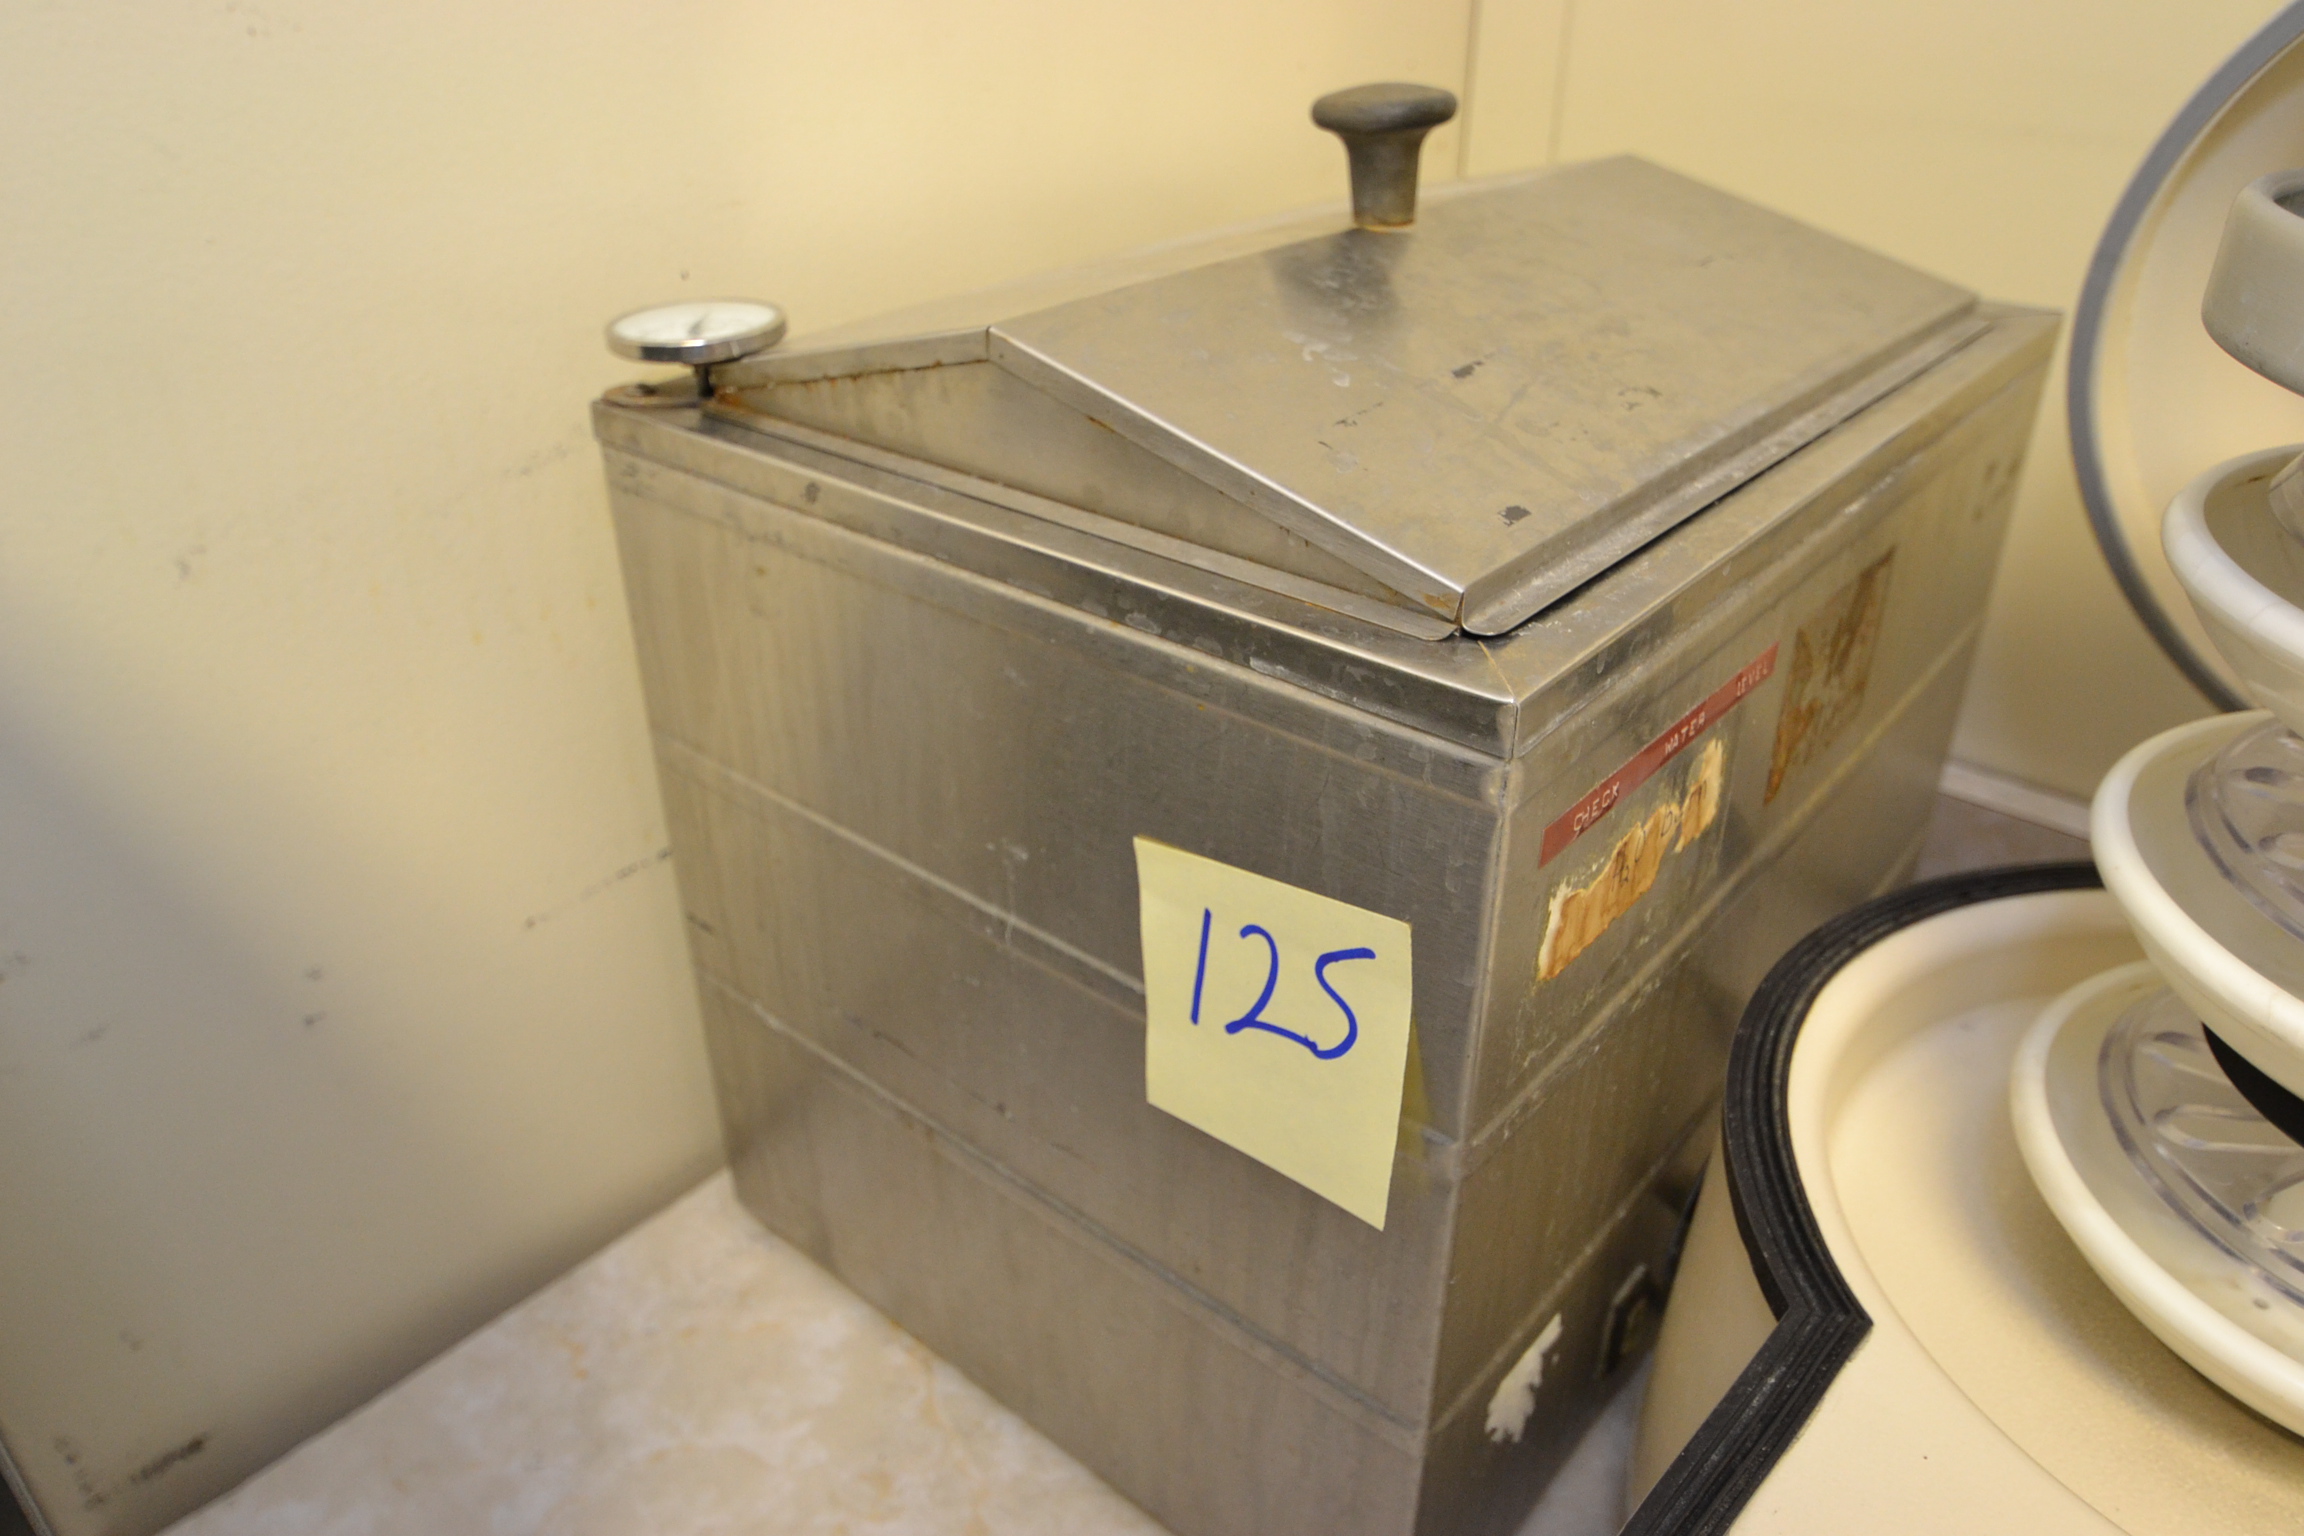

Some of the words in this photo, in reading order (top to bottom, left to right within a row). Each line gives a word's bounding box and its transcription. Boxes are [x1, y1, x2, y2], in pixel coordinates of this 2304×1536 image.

[1573, 780, 1620, 832] CHECK
[1664, 710, 1706, 754] WATER
[1736, 661, 1768, 697] LEVEL
[1190, 906, 1377, 1060] 125
